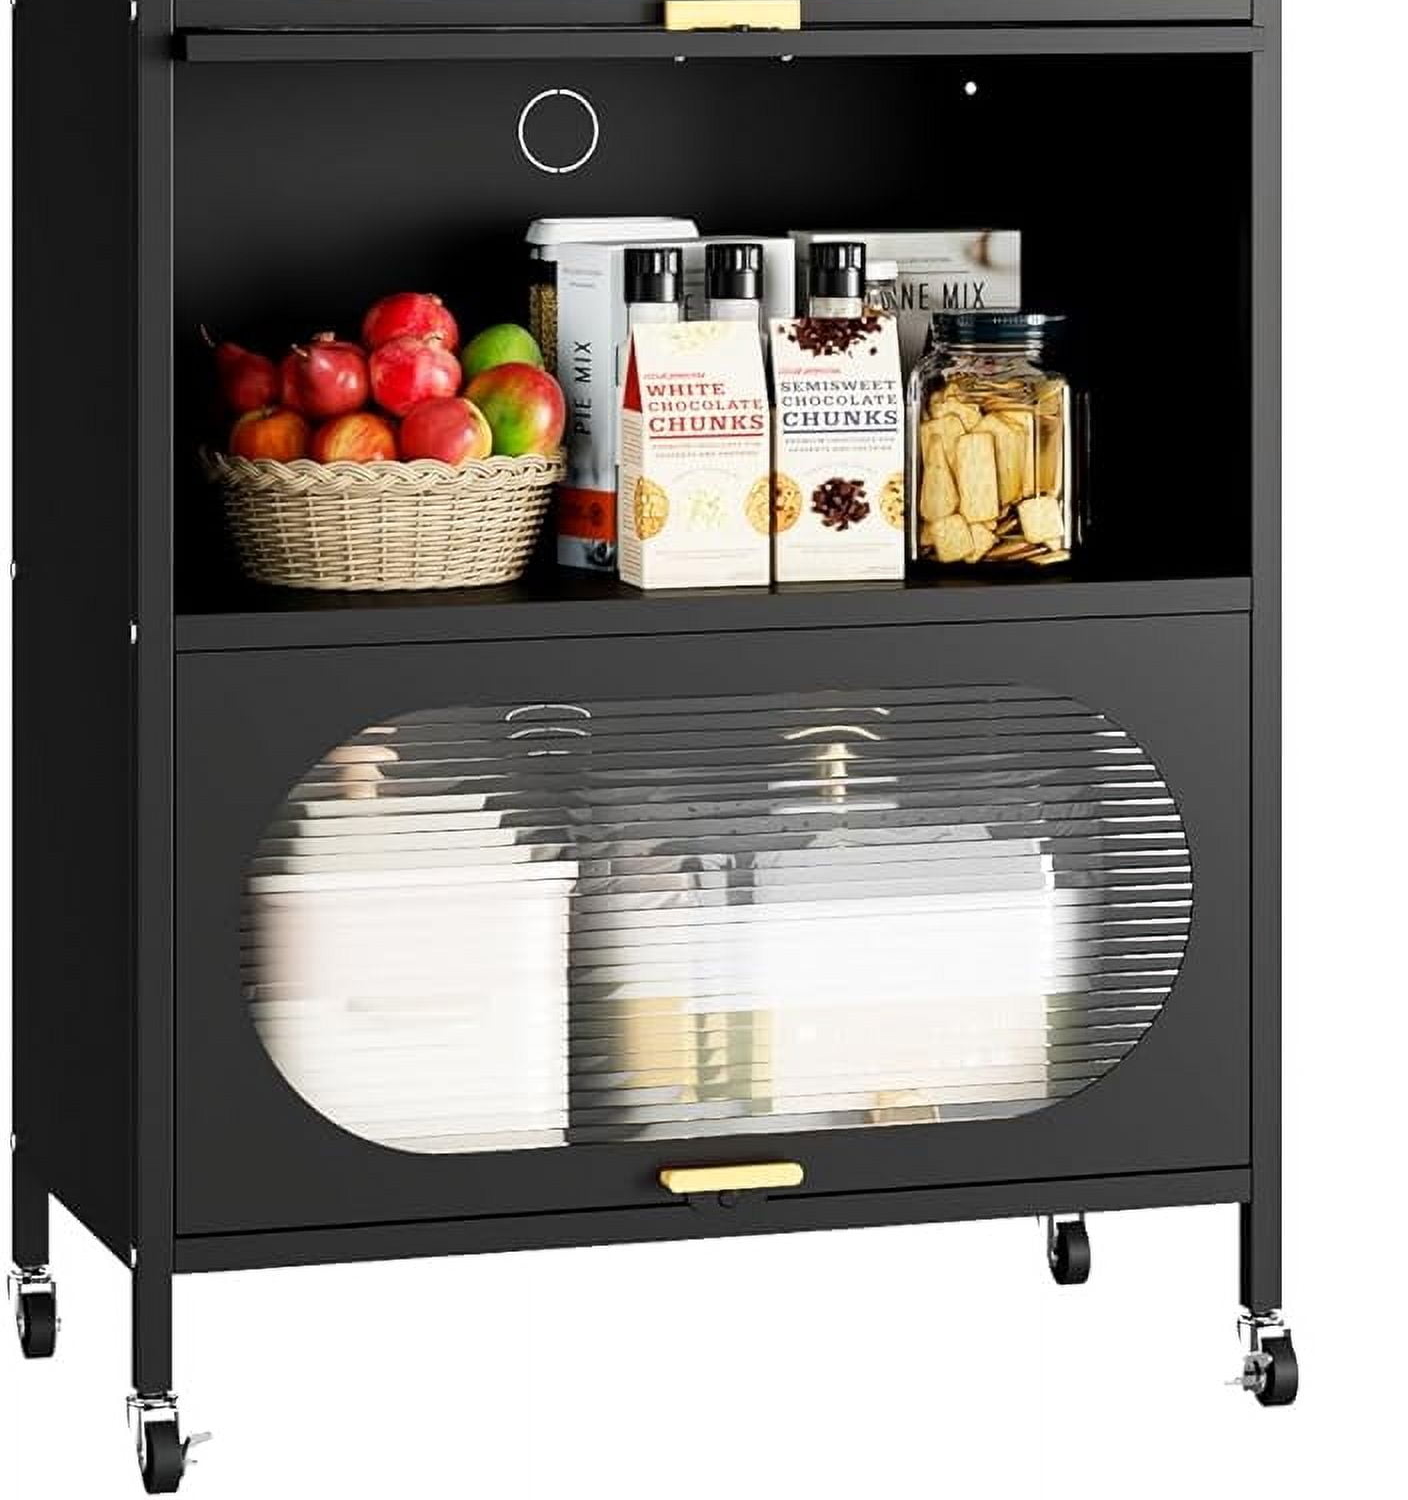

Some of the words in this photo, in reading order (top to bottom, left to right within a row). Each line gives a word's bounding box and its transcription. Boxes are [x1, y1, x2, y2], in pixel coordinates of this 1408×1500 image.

[942, 281, 985, 310] MIX
[574, 341, 592, 384] MIX
[646, 383, 726, 397] WHITE
[781, 380, 897, 393] SEMISWEET
[648, 398, 764, 413] CHOCOLATE
[782, 394, 897, 407] CHOCOLATE
[574, 397, 592, 436] PIE
[648, 414, 764, 433] CHUNKS
[783, 410, 897, 427] CHUNKS
